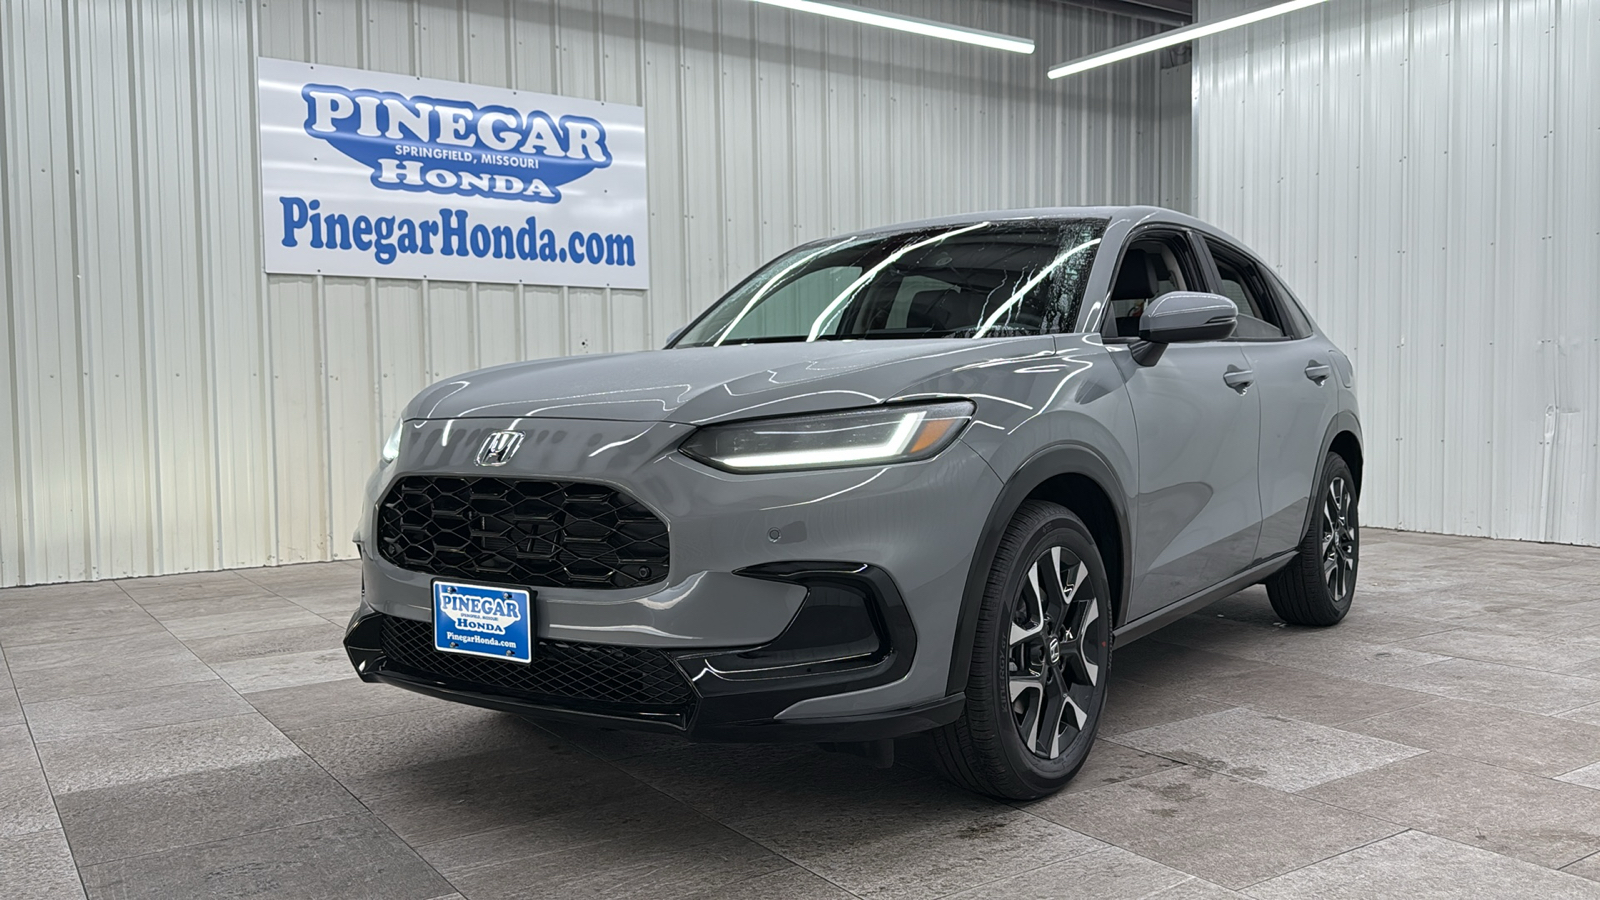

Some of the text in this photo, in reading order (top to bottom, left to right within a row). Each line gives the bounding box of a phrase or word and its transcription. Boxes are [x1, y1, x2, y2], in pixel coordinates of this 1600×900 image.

[308, 90, 607, 163] PINEGAR
[395, 144, 539, 169] SPRINGFIELD, MISSOURI
[378, 157, 556, 198] HONDA
[279, 196, 636, 265] PinegarHonda.com
[442, 595, 519, 618] PINEGAR
[456, 618, 504, 633] HONDA
[446, 631, 517, 649] PinegarHonda.com
